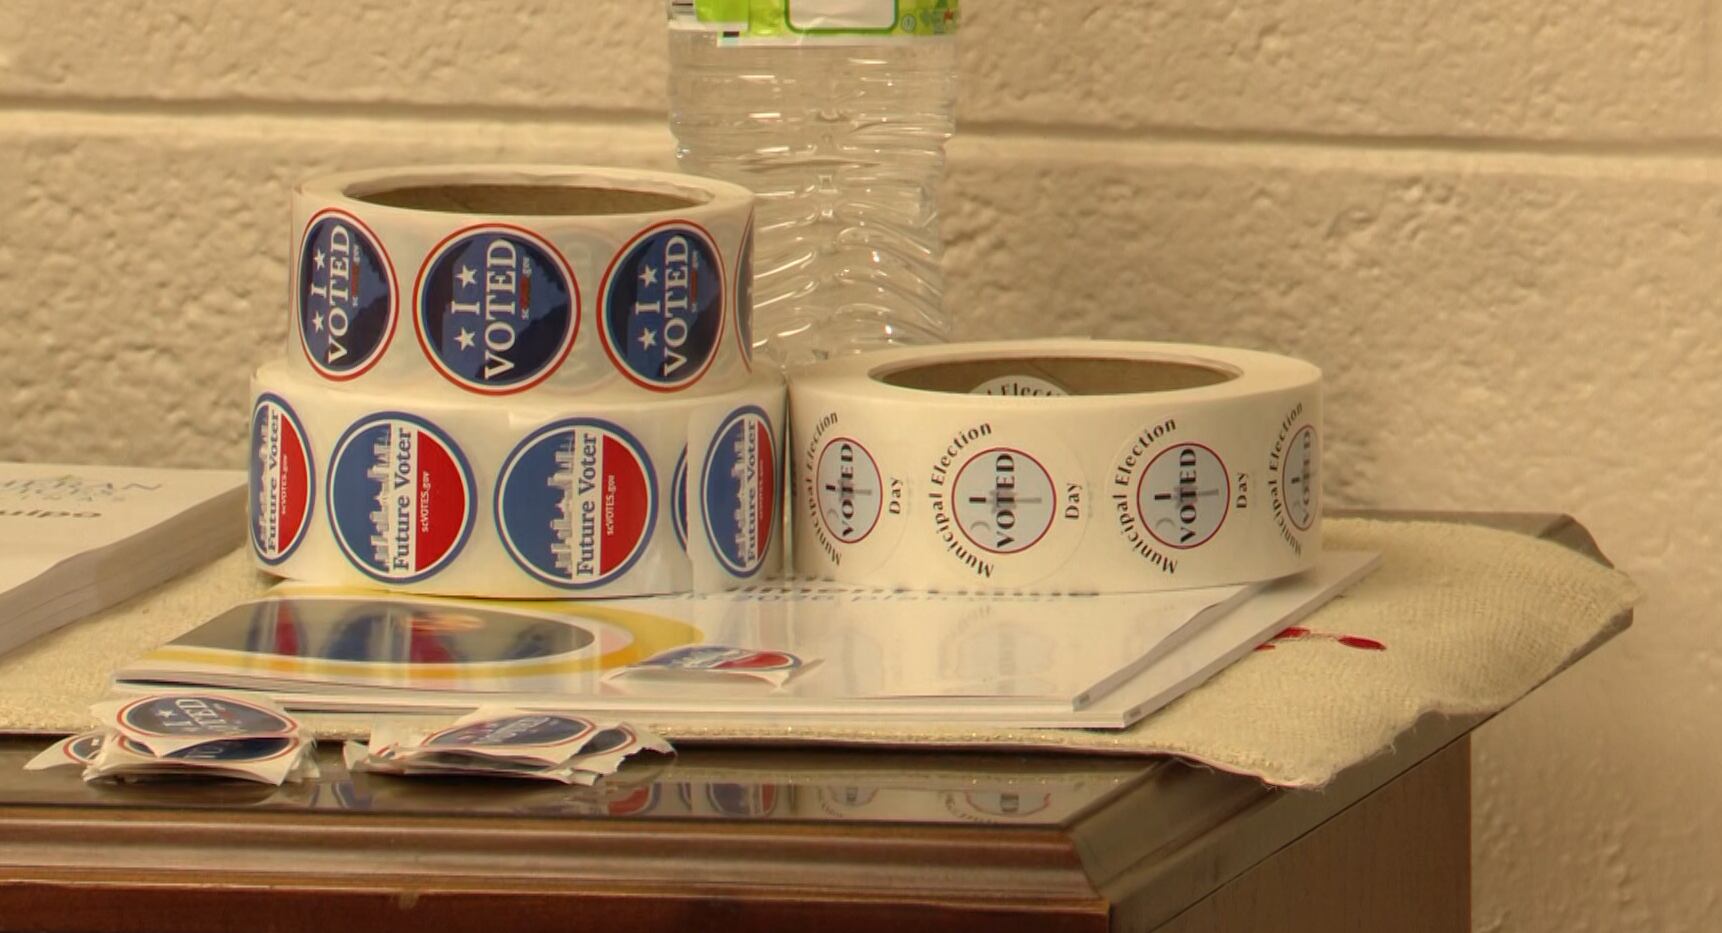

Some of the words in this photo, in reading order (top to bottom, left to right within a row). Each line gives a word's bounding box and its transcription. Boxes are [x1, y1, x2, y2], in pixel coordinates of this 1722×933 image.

[311, 282, 328, 299] I
[328, 224, 350, 365] VOTED
[451, 301, 481, 316] I
[484, 239, 517, 380] VOTED
[635, 300, 661, 316] I
[664, 235, 689, 377] VOTED
[269, 409, 280, 470] Voter
[394, 427, 412, 489] Voter
[578, 433, 597, 497] Voter
[746, 421, 756, 482] Voter
[806, 411, 839, 471] Election
[931, 422, 993, 486] Election
[1115, 418, 1177, 486] Election
[1269, 402, 1304, 472] Election
[267, 478, 278, 551] Future
[420, 470, 431, 533] scVOTES.gov
[605, 474, 616, 536] scVOTES.gov
[747, 487, 756, 561] Future
[805, 477, 843, 566] Municipal
[841, 443, 854, 537] VOTED
[888, 477, 904, 515] Day
[995, 453, 1016, 548] VOTED
[1064, 482, 1084, 521] Day
[1179, 448, 1197, 543] VOTED
[1235, 472, 1249, 509] Day
[393, 495, 411, 571] Future
[577, 500, 596, 577] Future
[928, 493, 994, 578] Municipal
[1112, 494, 1178, 574] Municipal
